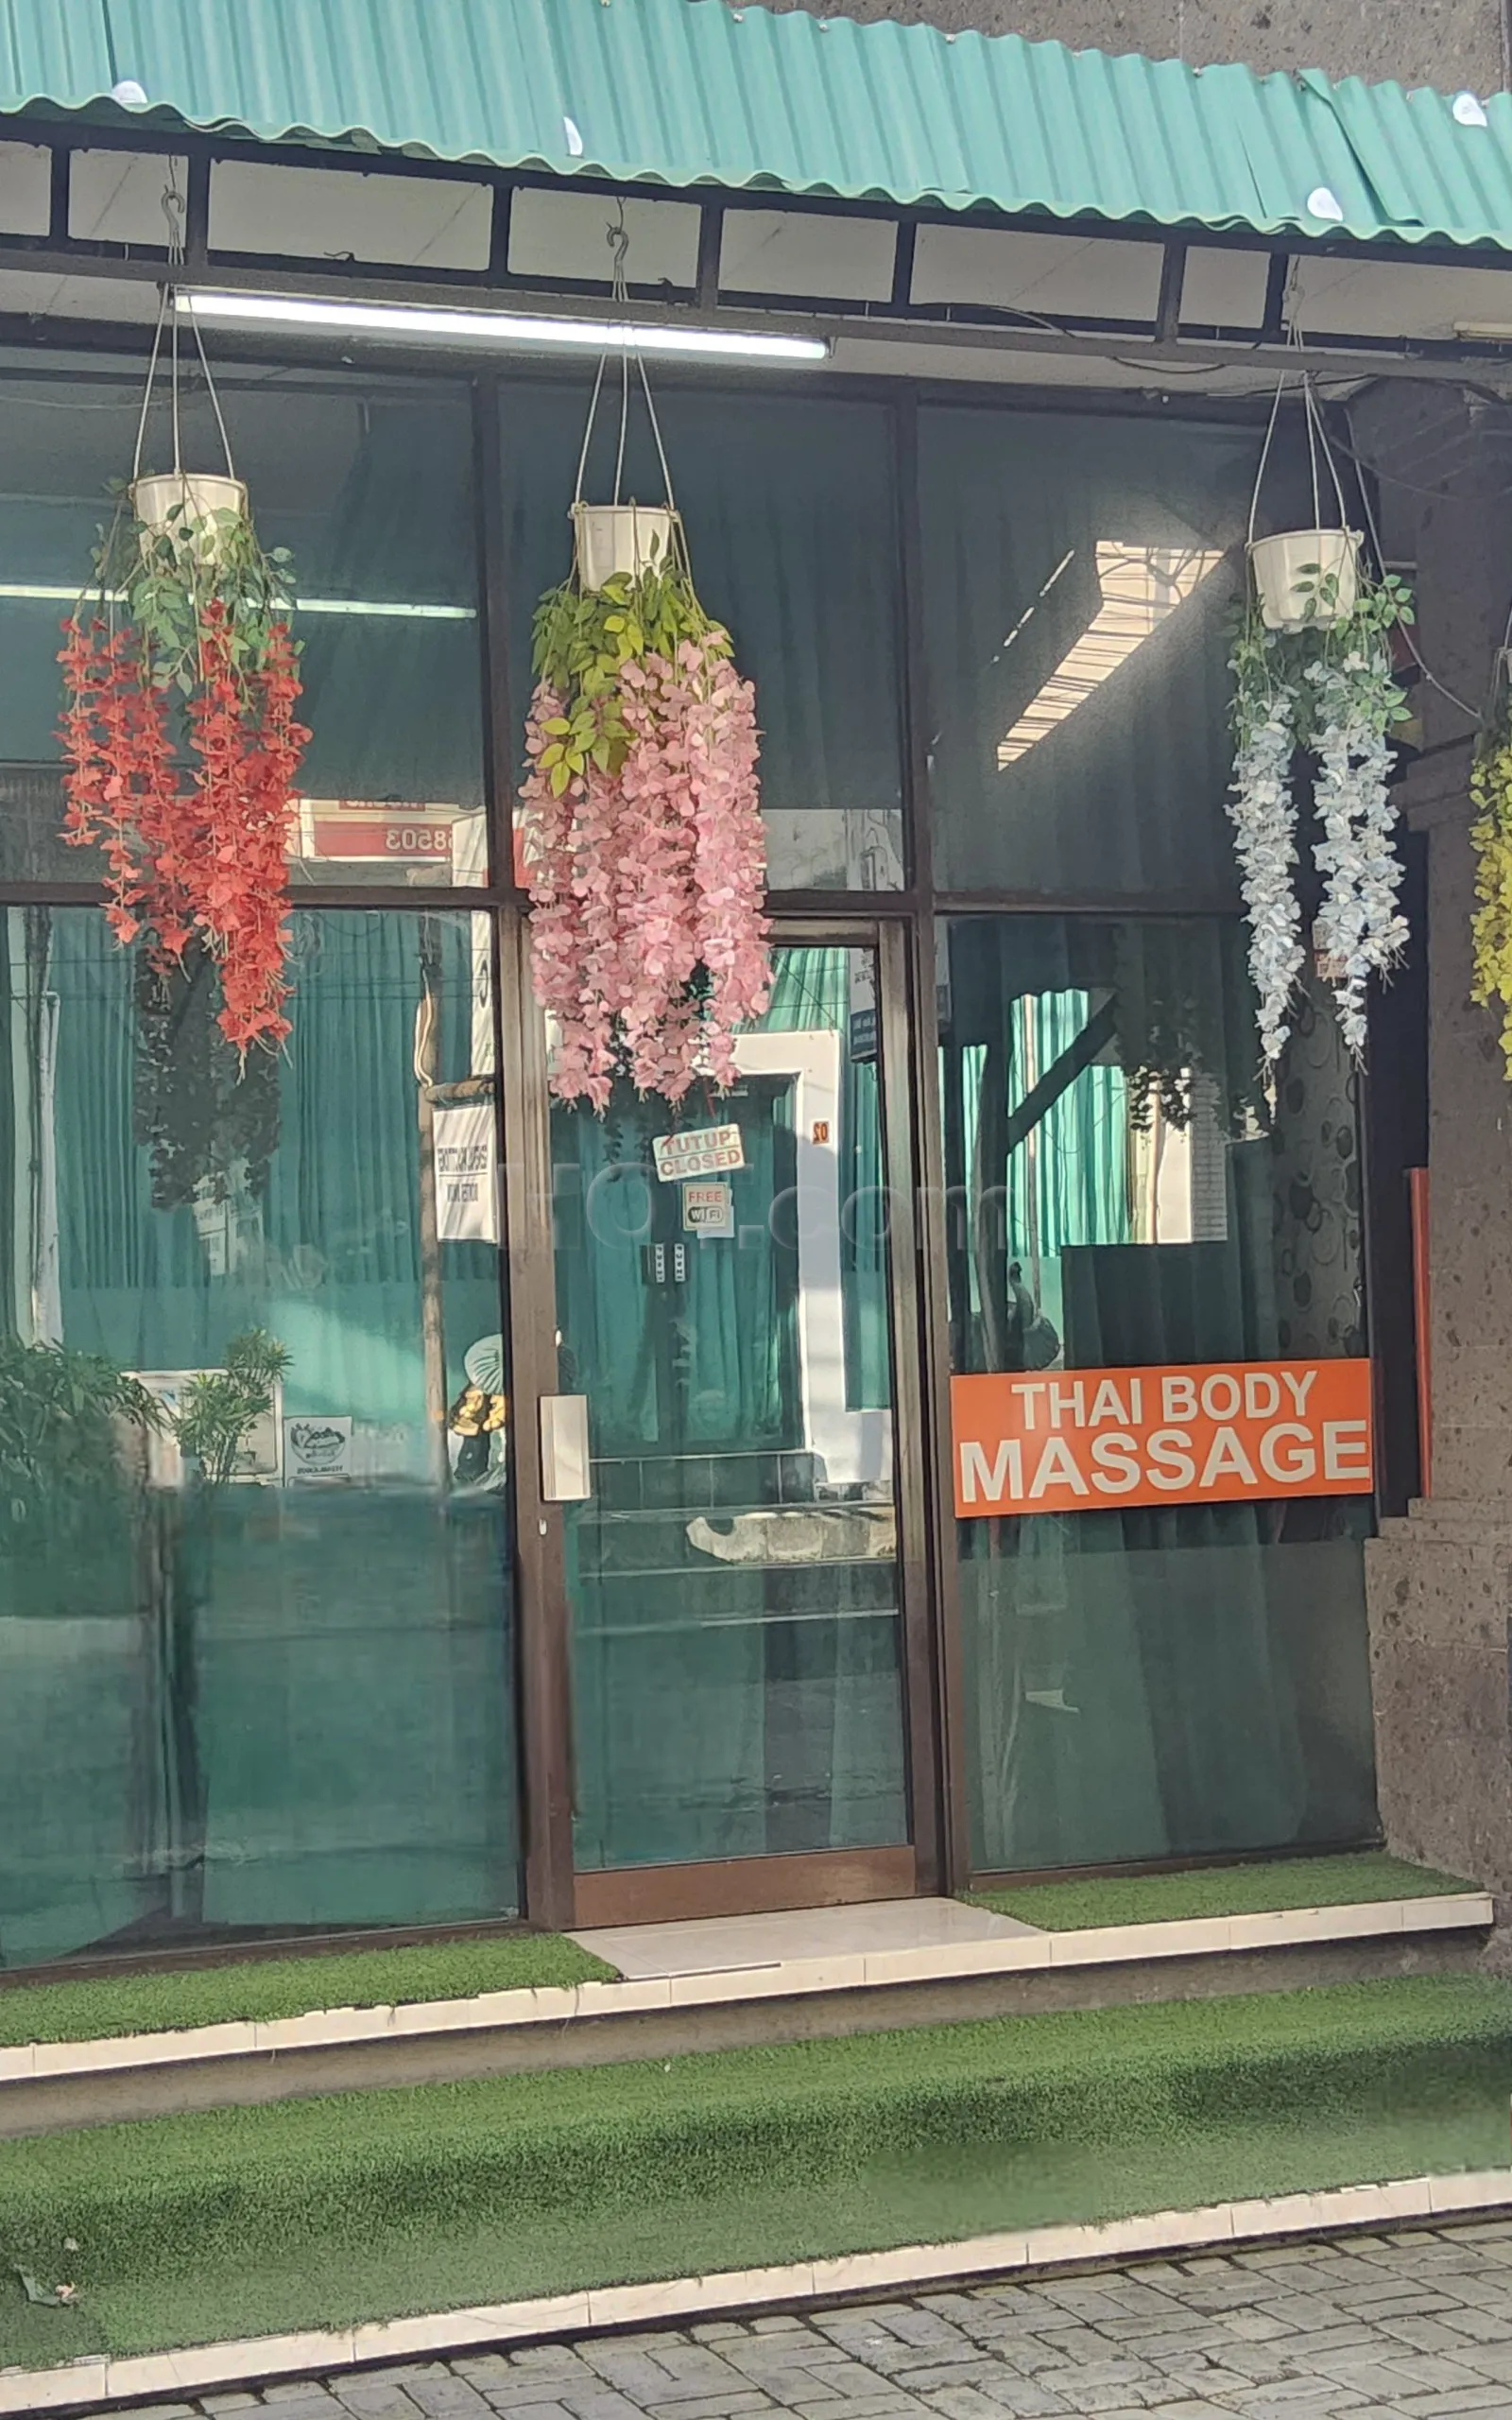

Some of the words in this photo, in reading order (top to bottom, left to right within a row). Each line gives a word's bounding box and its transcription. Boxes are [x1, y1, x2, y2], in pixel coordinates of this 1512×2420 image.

[663, 1130, 731, 1155] TUTUP
[662, 1150, 741, 1176] CLOSED
[688, 1191, 723, 1202] FREE
[1011, 1378, 1142, 1430] THAI
[1161, 1371, 1317, 1423] BODY
[959, 1420, 1370, 1503] MASSAGE
